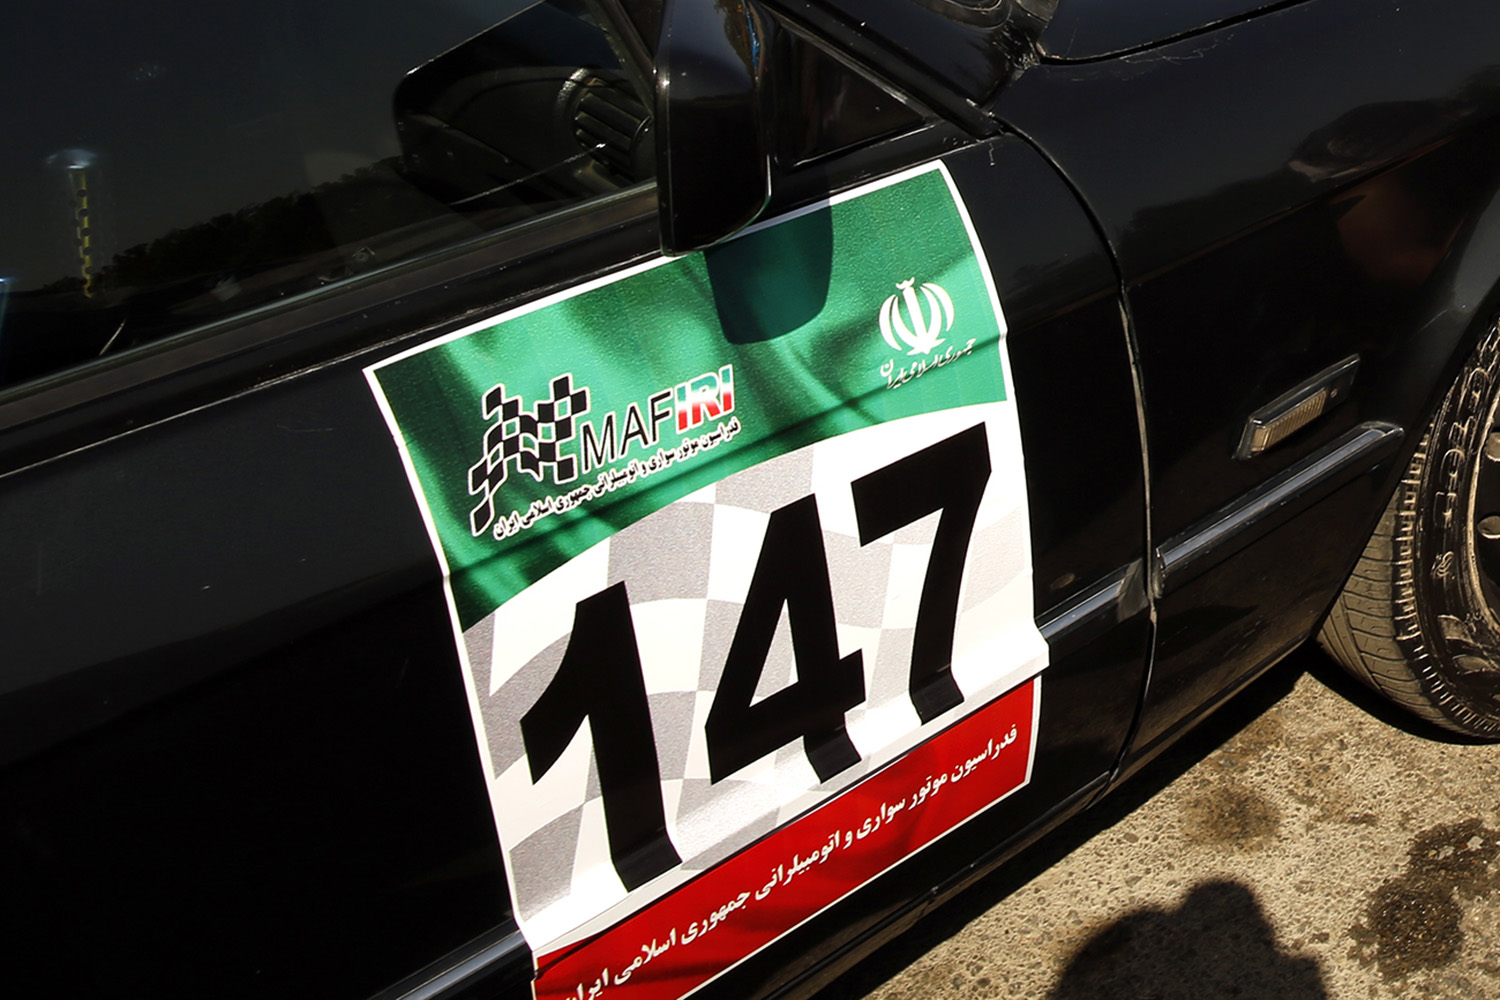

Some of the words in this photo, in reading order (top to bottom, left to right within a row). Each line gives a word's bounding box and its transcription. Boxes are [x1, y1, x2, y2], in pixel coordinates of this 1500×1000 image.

[677, 437, 699, 458] موتور
[702, 417, 740, 447] فدراسیون
[649, 450, 675, 471] سواری
[522, 497, 553, 525] اسلامی
[555, 485, 591, 511] جمهوری
[495, 514, 520, 539] ایران
[519, 421, 992, 895] 147
[950, 724, 1018, 783] فدراسیون
[908, 772, 948, 810] موتور
[856, 798, 906, 840] سواری
[843, 830, 853, 849] و
[754, 830, 840, 901] اتومبیلرانی
[680, 891, 751, 944] جمهوری
[613, 928, 677, 986] اسلامی
